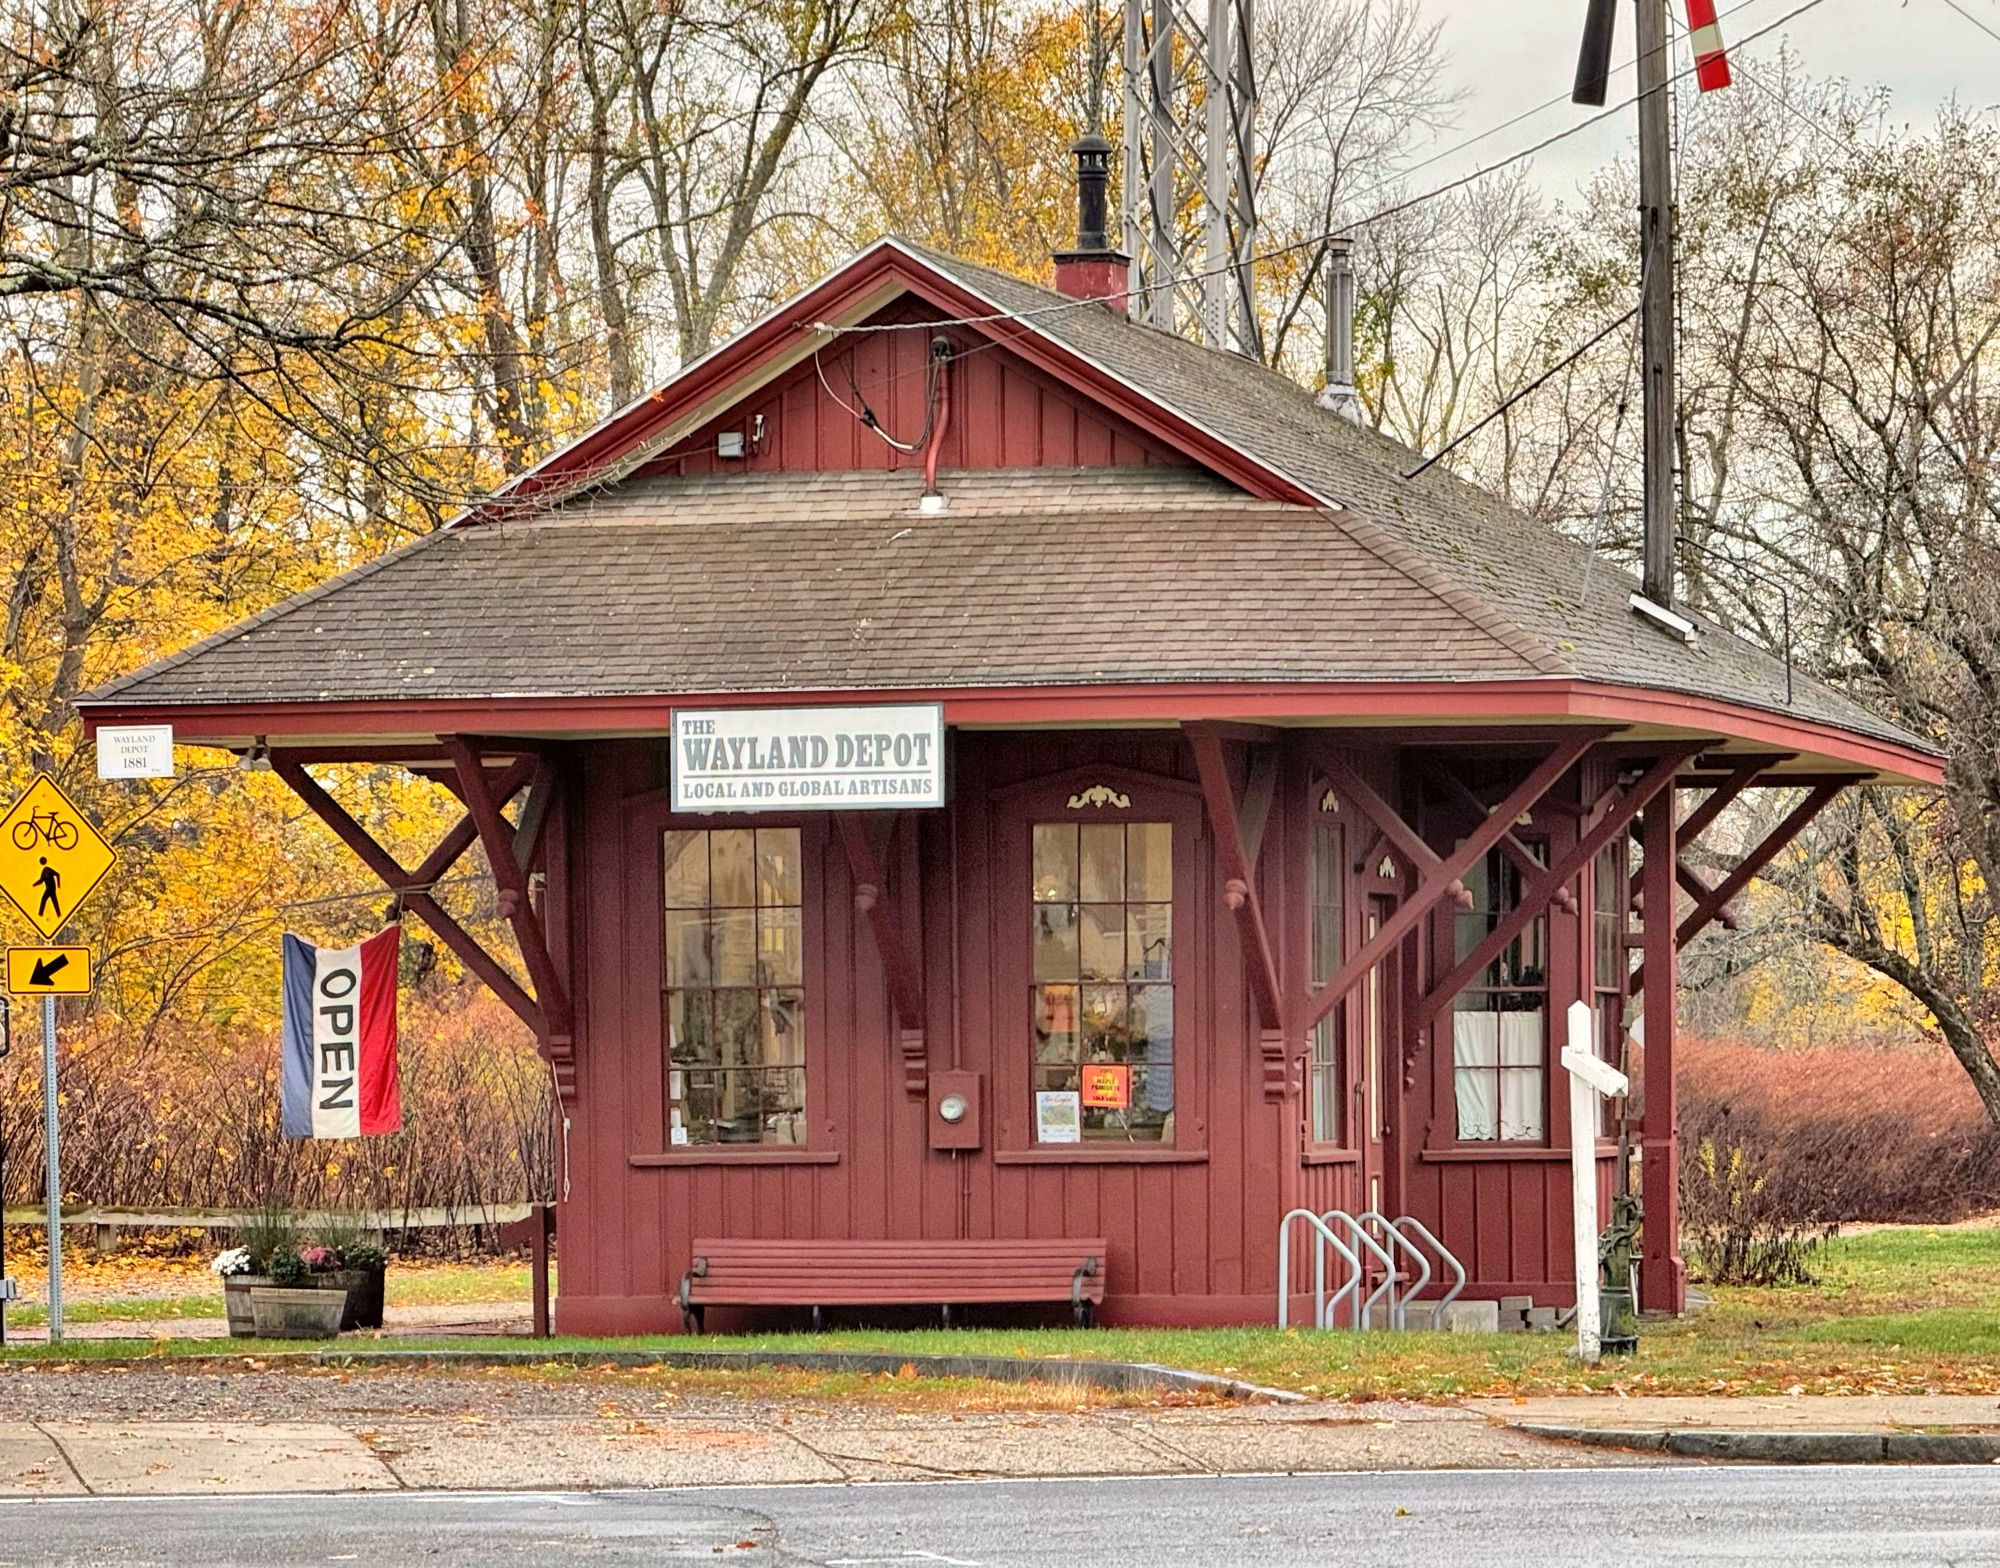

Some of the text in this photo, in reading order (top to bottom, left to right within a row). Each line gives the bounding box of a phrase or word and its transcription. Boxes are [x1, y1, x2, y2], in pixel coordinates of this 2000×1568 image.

[682, 719, 715, 735] THE
[113, 735, 156, 744] WAYLAND
[121, 745, 149, 754] DEPOT
[682, 733, 931, 771] WAYLAND DEPOT
[123, 757, 147, 769] 1881
[683, 778, 932, 799] LOCAL AND GLOBAL ARTISANS
[319, 968, 357, 1110] OPEN
